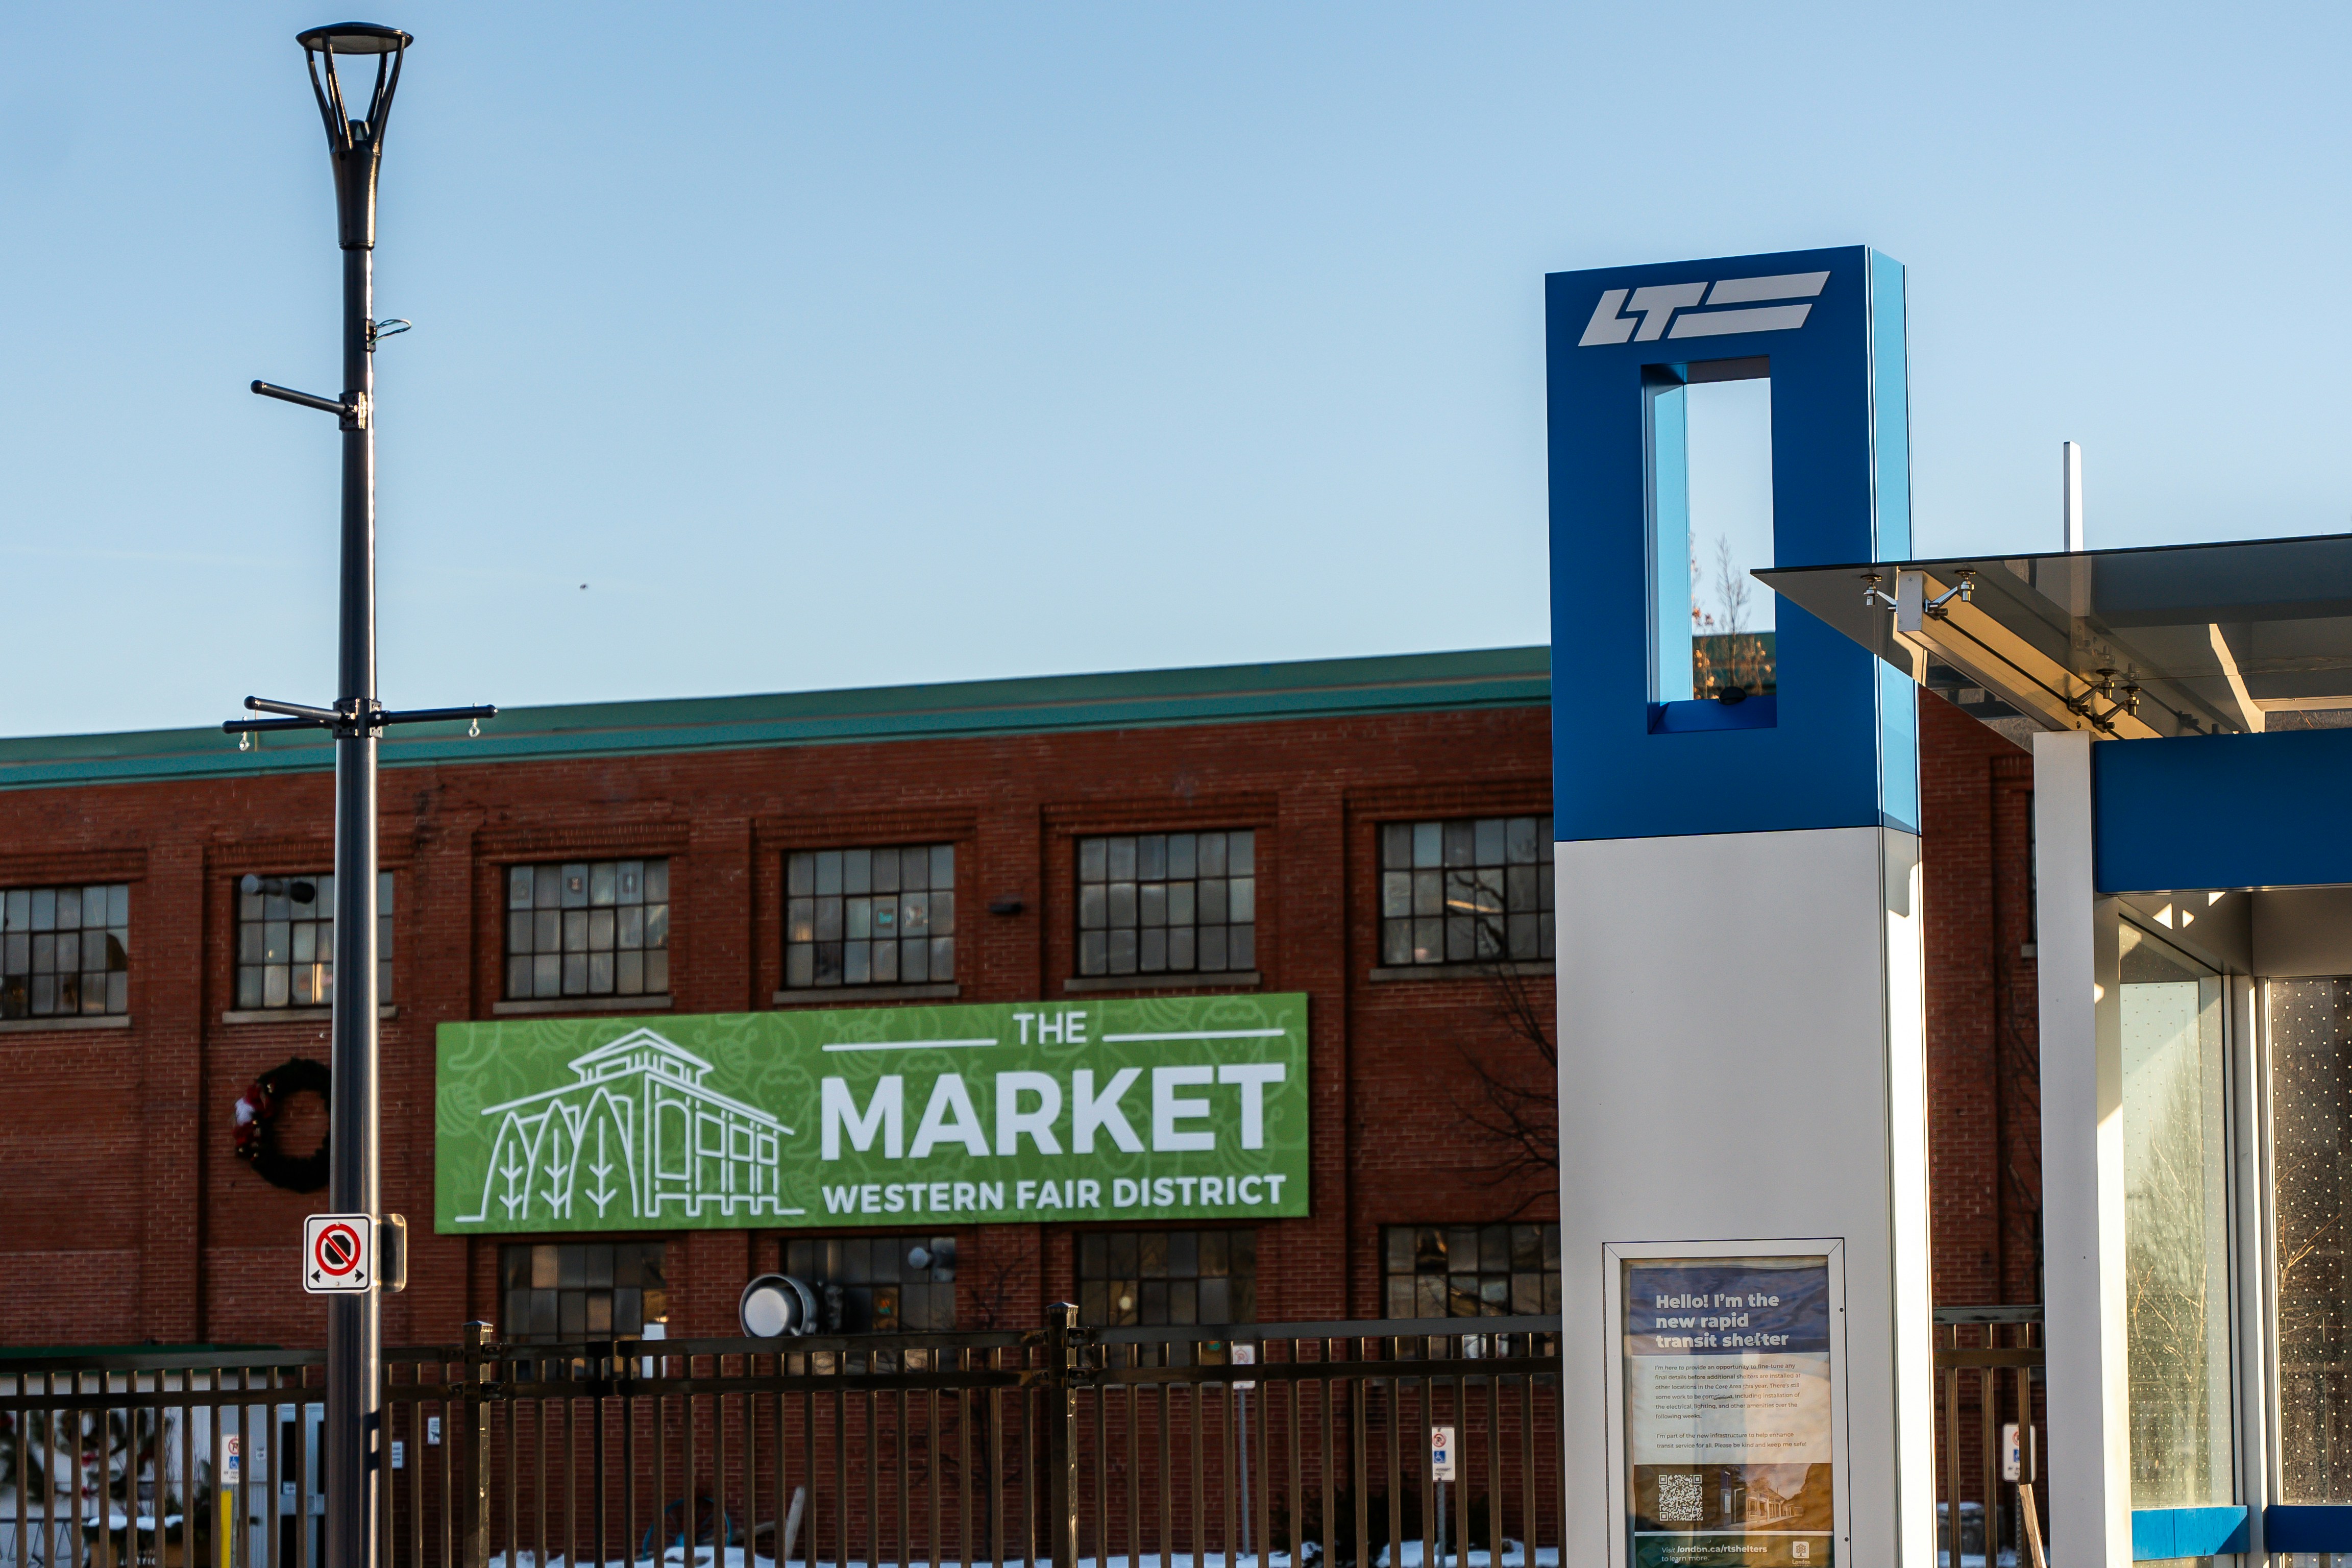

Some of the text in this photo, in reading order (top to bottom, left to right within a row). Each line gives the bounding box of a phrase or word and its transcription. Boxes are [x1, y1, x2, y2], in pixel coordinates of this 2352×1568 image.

[1012, 1011, 1088, 1045] THE
[821, 1062, 1286, 1161] MARKET
[822, 1174, 1287, 1214] WESTERN FAIR DISTRICT
[1656, 1292, 1779, 1309] Hello! I'm the
[1656, 1312, 1749, 1331] new rapid
[1656, 1332, 1789, 1348] transit shelter
